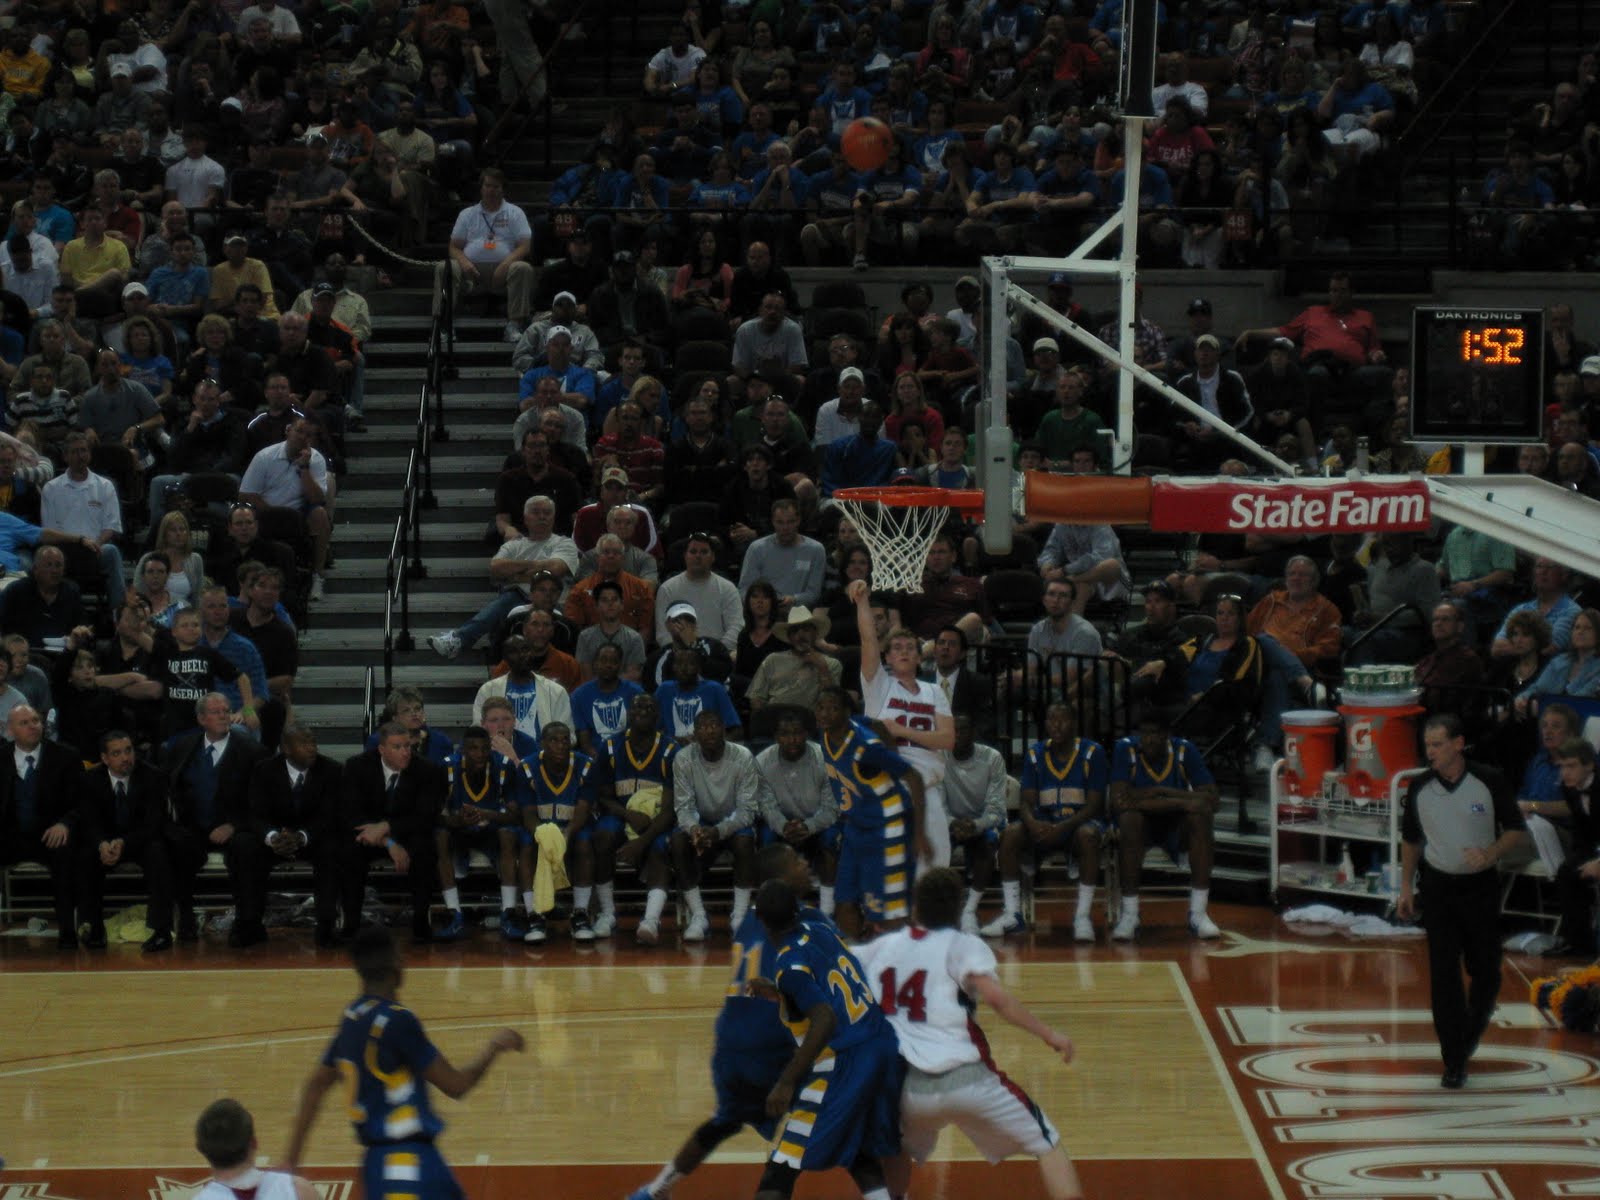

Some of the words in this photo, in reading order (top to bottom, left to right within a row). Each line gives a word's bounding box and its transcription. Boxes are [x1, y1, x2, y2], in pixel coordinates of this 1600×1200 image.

[1435, 310, 1523, 320] DAKTRONICS
[1462, 327, 1525, 364] 1:52
[1229, 493, 1326, 529] State
[1329, 490, 1425, 527] Farm
[181, 659, 209, 674] HEELS
[1350, 721, 1373, 752] G
[827, 954, 874, 1025] 23
[879, 966, 928, 1022] 14
